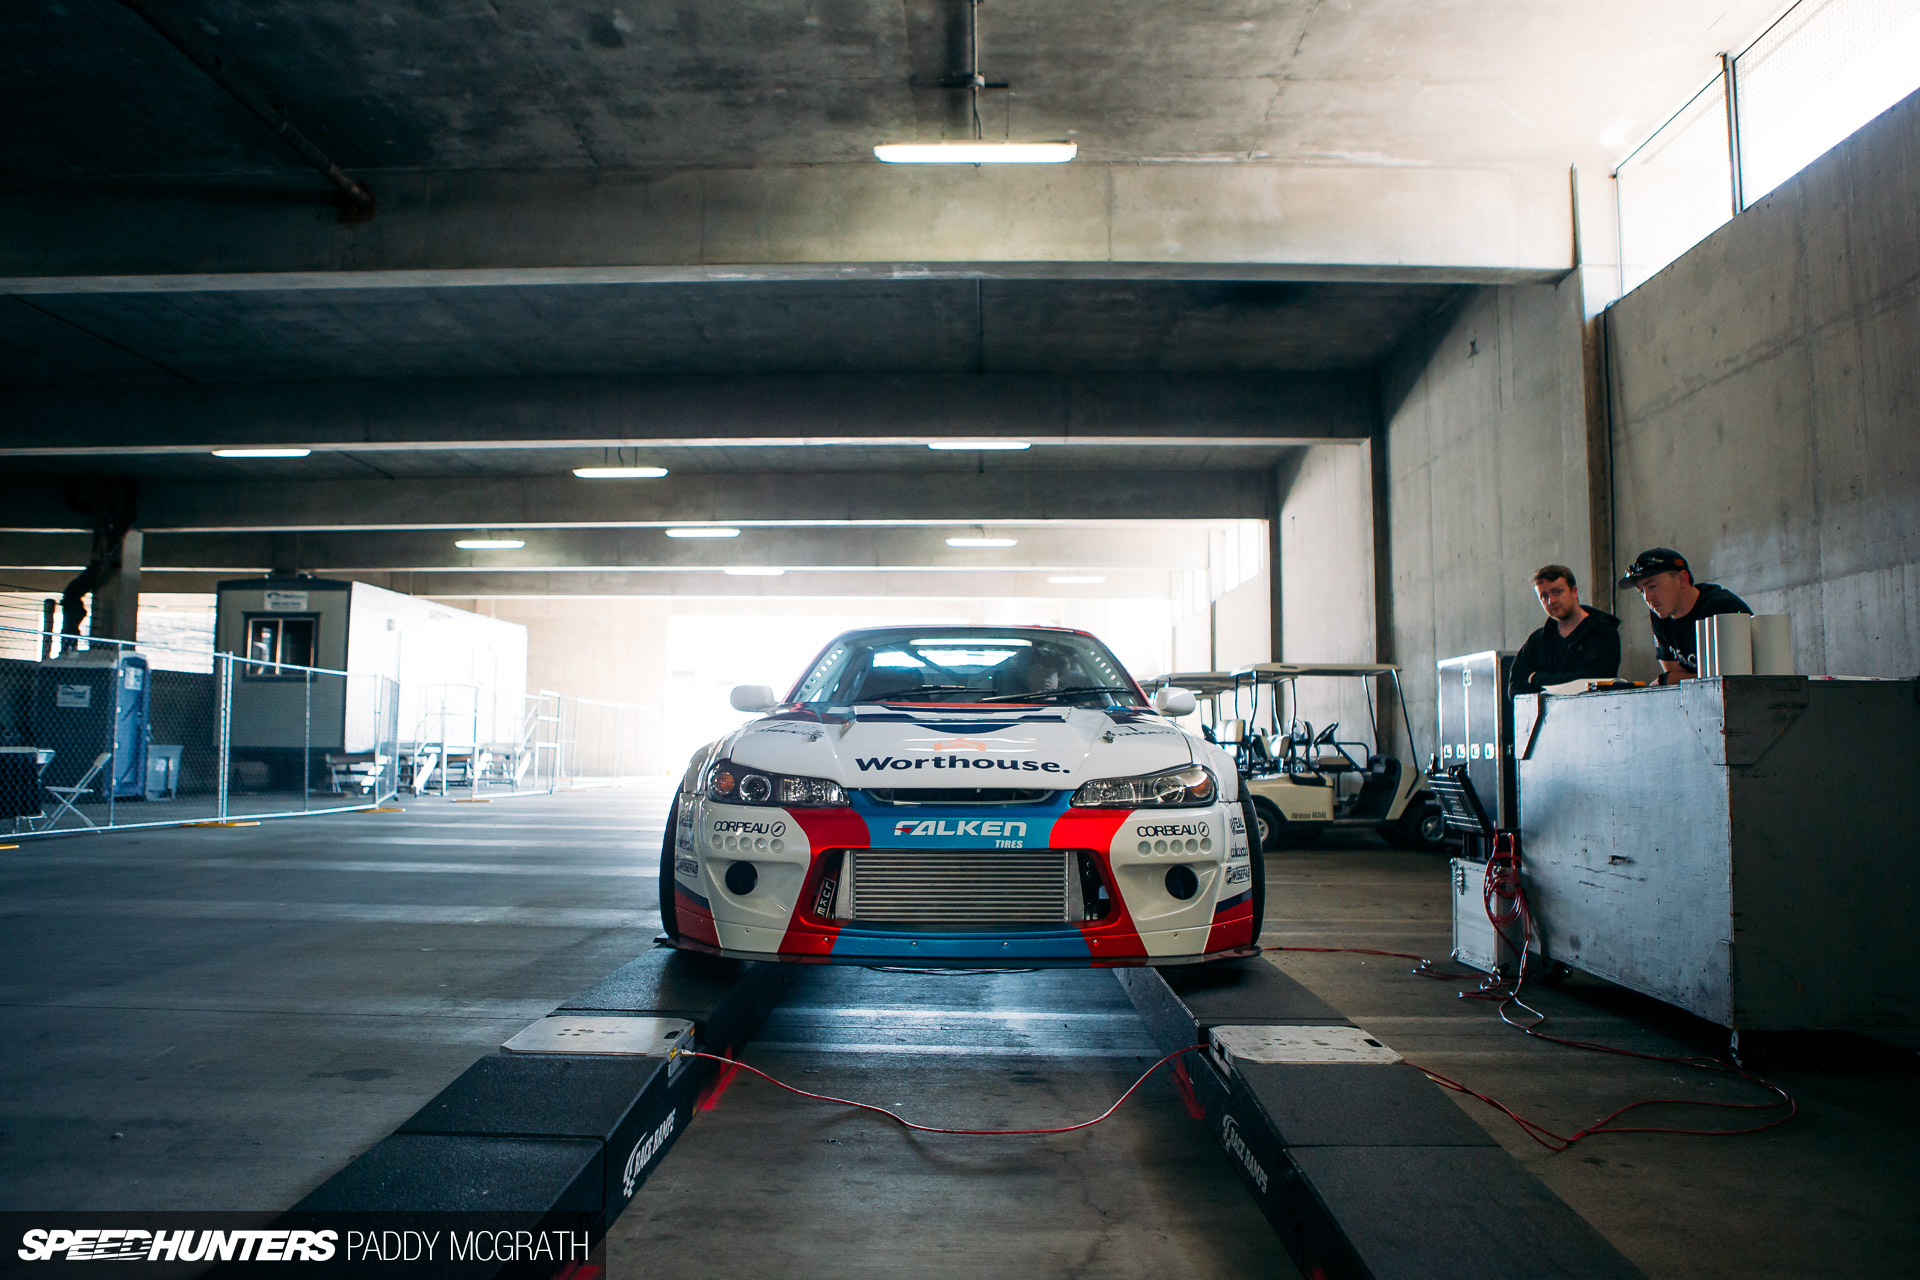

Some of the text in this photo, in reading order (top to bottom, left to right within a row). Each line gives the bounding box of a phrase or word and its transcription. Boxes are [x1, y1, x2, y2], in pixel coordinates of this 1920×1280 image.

[855, 755, 1071, 774] Worthouse.
[714, 820, 770, 834] CORBEAU
[893, 820, 1028, 837] FALKEN
[1137, 824, 1197, 837] CORBEAU
[995, 839, 1023, 849] TIRES
[817, 881, 832, 916] LUKE
[633, 1108, 676, 1178] RACE RAMPS
[1230, 1127, 1268, 1194] RACE RAMPS
